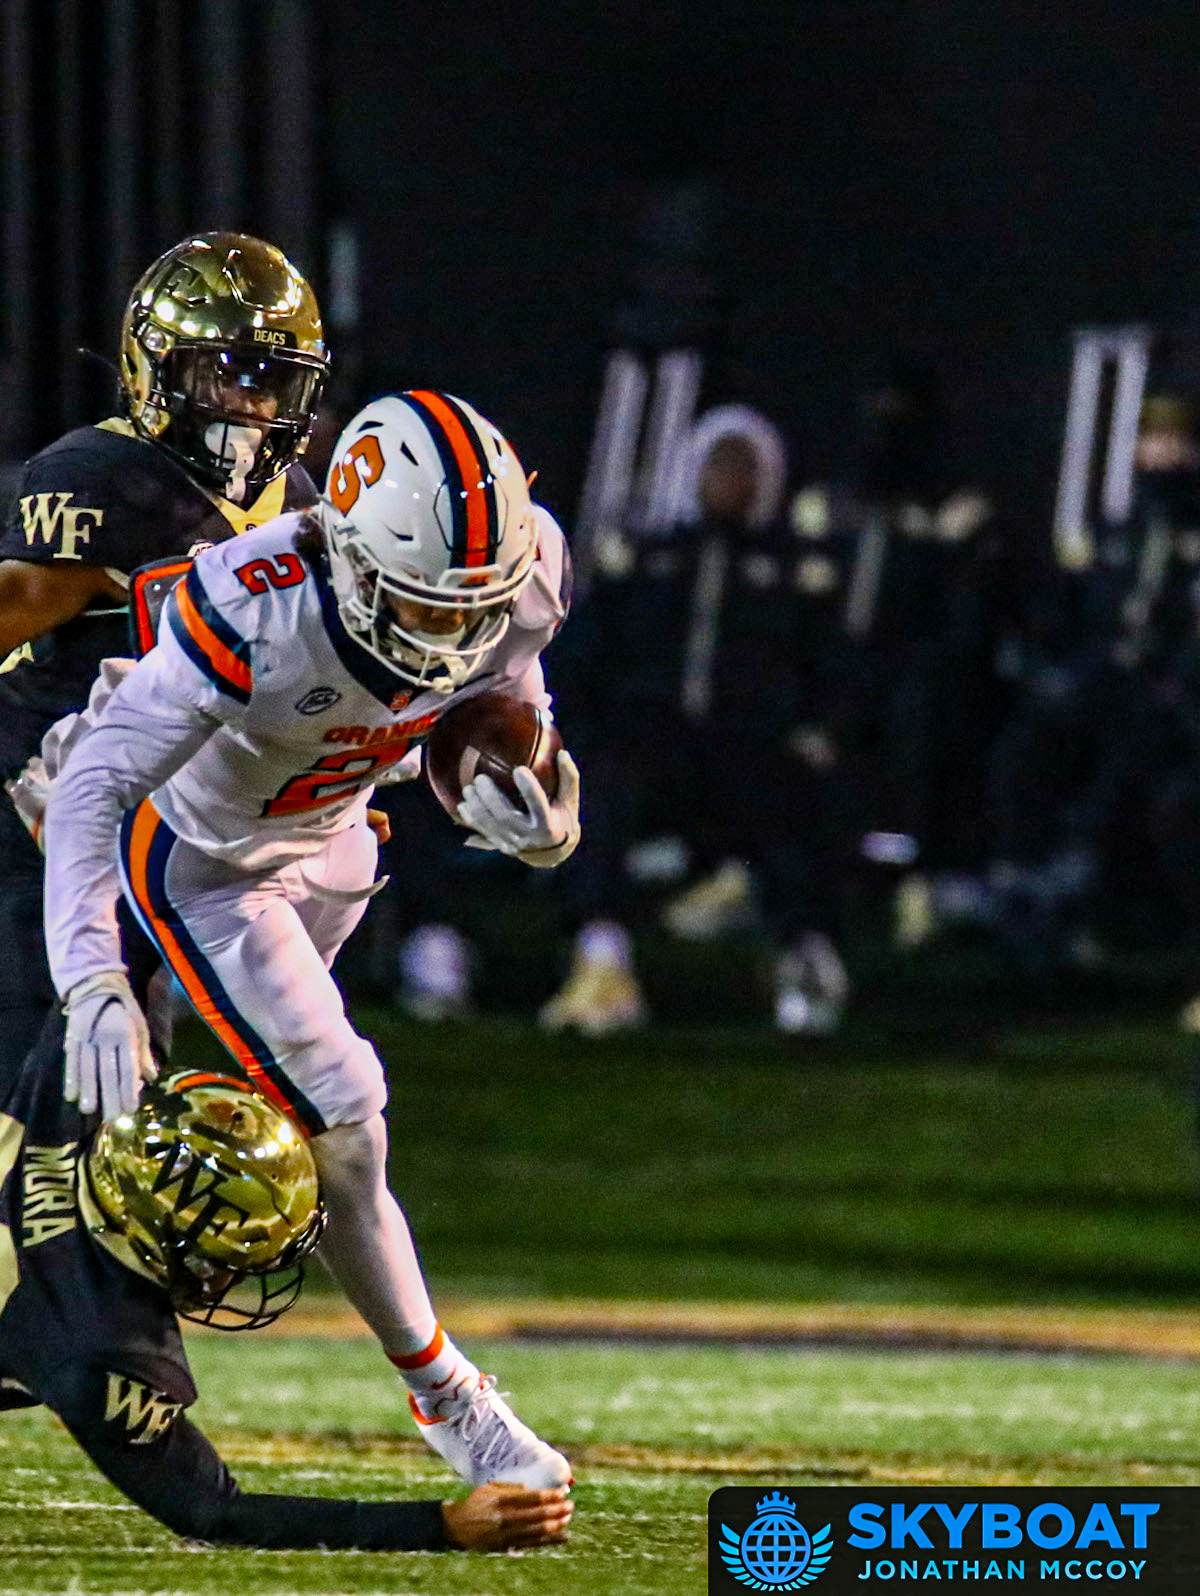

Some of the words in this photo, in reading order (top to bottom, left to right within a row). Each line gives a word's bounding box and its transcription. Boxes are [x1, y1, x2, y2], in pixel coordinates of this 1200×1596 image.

[253, 329, 286, 346] DEACS
[19, 491, 104, 560] WF
[232, 553, 306, 596] 2
[260, 737, 410, 818] 2
[22, 1141, 79, 1248] MORA
[152, 1136, 251, 1246] WF
[104, 1371, 183, 1444] WF
